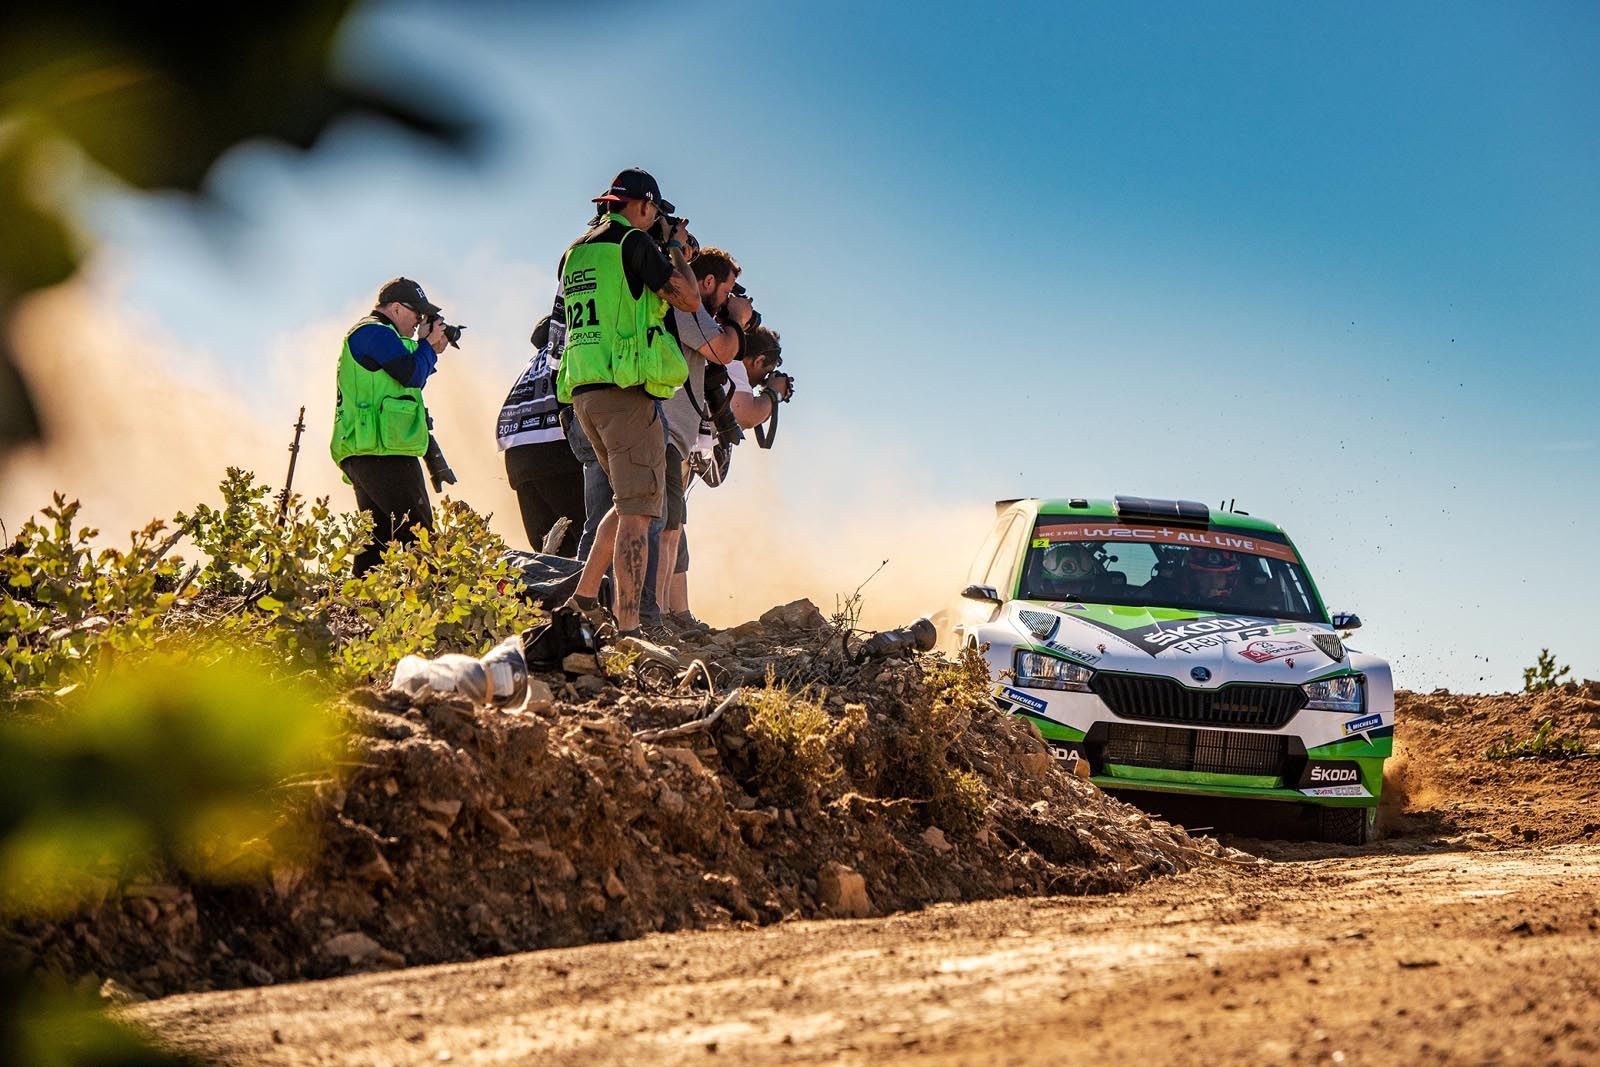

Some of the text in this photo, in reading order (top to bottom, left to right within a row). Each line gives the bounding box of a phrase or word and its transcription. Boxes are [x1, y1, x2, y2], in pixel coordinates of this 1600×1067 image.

[563, 268, 596, 286] WRC
[568, 299, 599, 330] 021
[499, 423, 518, 434] 2019
[1178, 532, 1211, 544] ALL
[1215, 537, 1254, 550] LIVE
[1144, 617, 1263, 646] ŠKODA
[1174, 632, 1237, 654] FABIA
[1238, 624, 1300, 641] R5
[1010, 693, 1043, 709] MICHELIN
[1352, 718, 1379, 729] MICHELIN
[1311, 766, 1357, 781] ŠKODA
